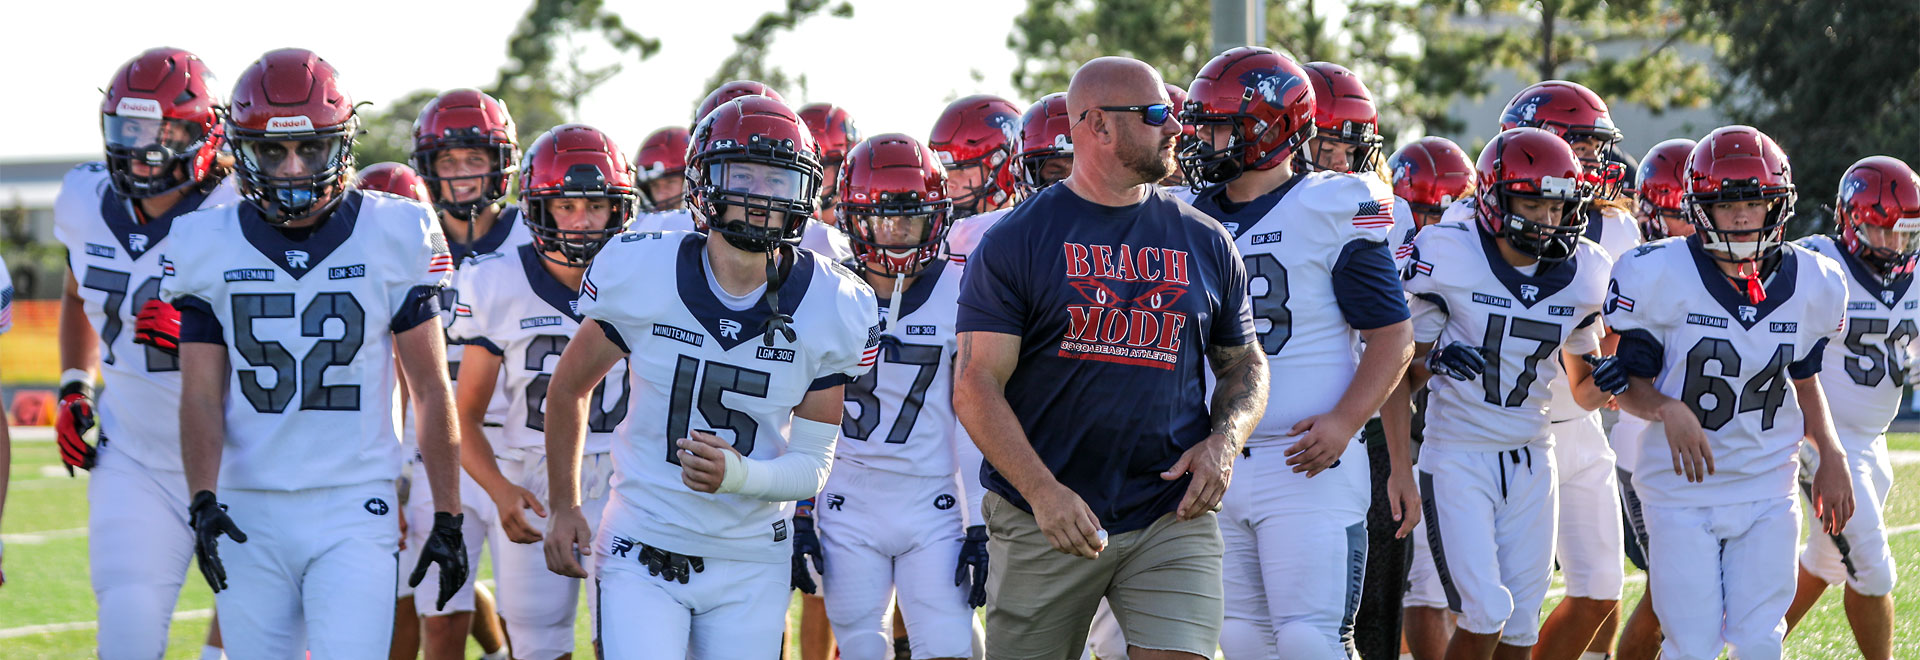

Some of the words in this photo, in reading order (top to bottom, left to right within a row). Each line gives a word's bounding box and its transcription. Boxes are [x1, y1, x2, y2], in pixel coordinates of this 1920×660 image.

[272, 120, 306, 128] Riddell
[1252, 231, 1281, 244] LGM-30G
[1063, 242, 1190, 285] BEACH
[224, 269, 264, 281] MINUTEMAN
[330, 265, 365, 279] LGM-30G
[1473, 293, 1505, 306] MINUTEMAN
[1549, 306, 1574, 316] LGM-30G
[1688, 314, 1721, 327] MINUTEMAN
[1771, 322, 1797, 332] LGM-30G
[654, 325, 695, 344] MINUTEMAN
[907, 326, 935, 335] LGM-30G
[1063, 306, 1186, 352] MODE
[230, 291, 365, 414] 52
[757, 347, 794, 361] LGM-30G
[1129, 348, 1178, 364] ATHLETICS
[1482, 313, 1562, 408] 17
[1681, 336, 1795, 431] 64
[666, 353, 771, 467] 15
